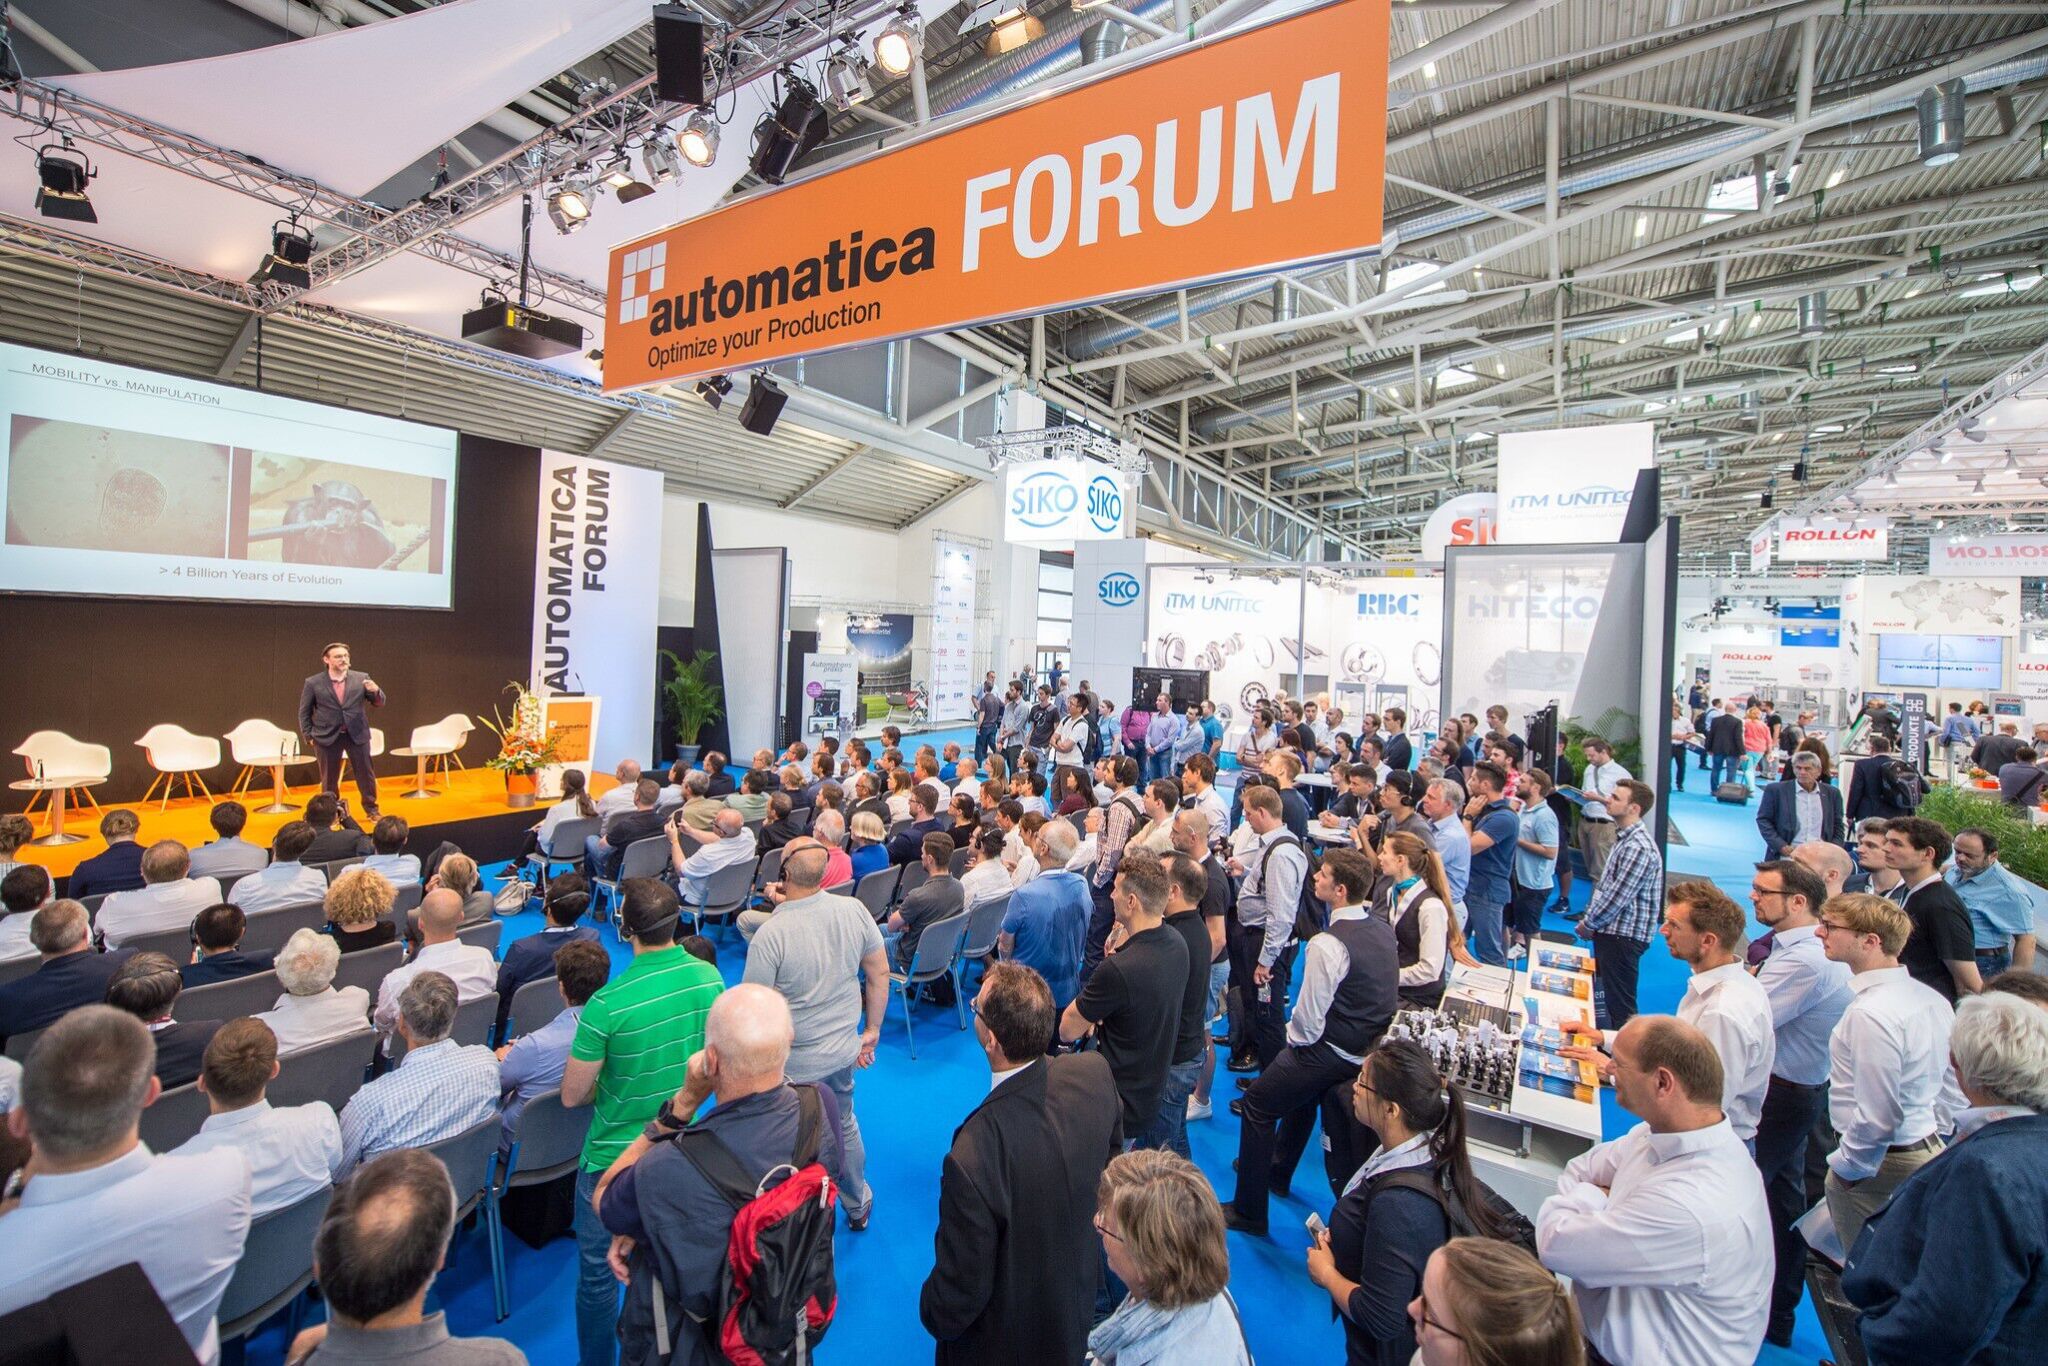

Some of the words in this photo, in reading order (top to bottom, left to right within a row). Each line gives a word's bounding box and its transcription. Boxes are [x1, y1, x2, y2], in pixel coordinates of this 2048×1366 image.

[650, 226, 936, 337] automatica
[961, 71, 1341, 274] FORUM
[648, 336, 717, 371] Optimize
[722, 329, 763, 359] your
[768, 300, 881, 343] Production
[32, 363, 102, 384] MOBILITY
[104, 377, 121, 388] vs.
[126, 380, 221, 406] MANIPULATION
[1012, 484, 1079, 515] SIKO
[1087, 485, 1122, 522] SIKO
[582, 468, 610, 592] FORUM
[1785, 529, 1876, 541] ROLLON
[172, 566, 182, 577] 4
[187, 566, 228, 580] Billion
[232, 569, 269, 582] Years
[272, 572, 285, 583] of
[288, 573, 343, 586] Evolution
[544, 465, 578, 692] AUTOMATICA
[1098, 580, 1140, 599] SIKO
[1357, 593, 1419, 616] RBC
[1467, 594, 1600, 620] HITECO
[810, 660, 852, 669] Automations
[1722, 653, 1773, 661] ROLLON
[1907, 715, 1920, 763] PRODUKTE
